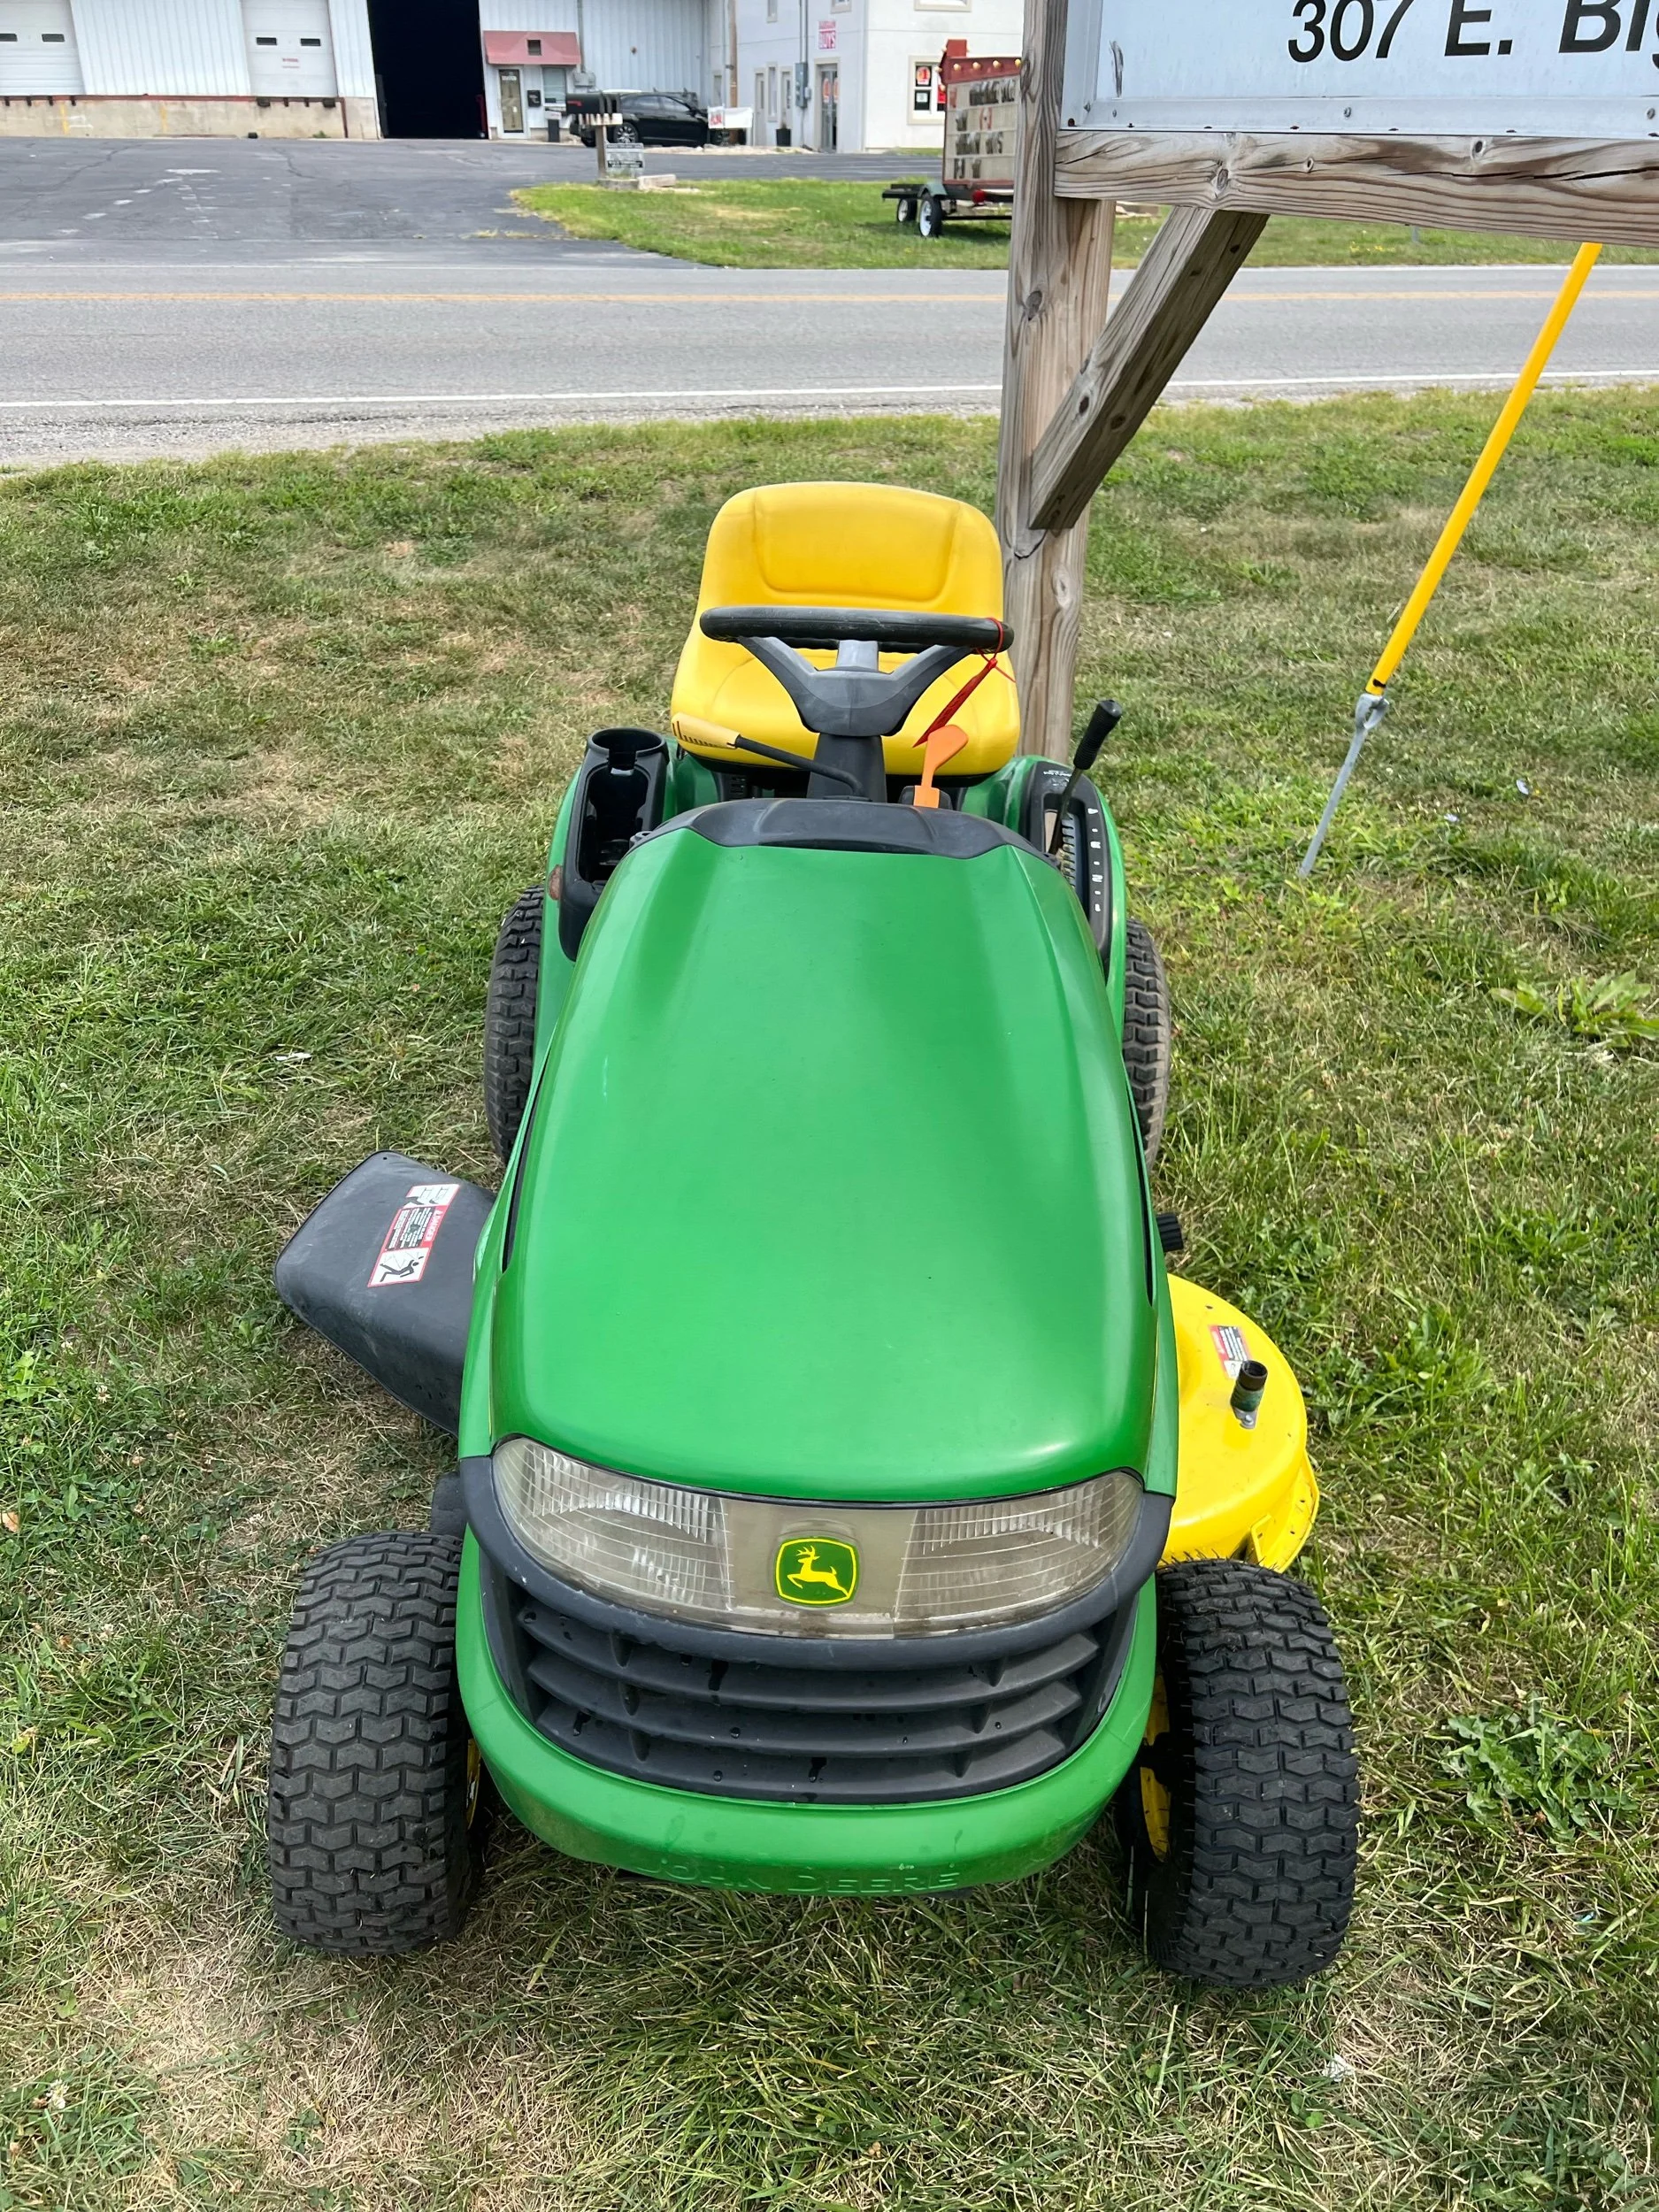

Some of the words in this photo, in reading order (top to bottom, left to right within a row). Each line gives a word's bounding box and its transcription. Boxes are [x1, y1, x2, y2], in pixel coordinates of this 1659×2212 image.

[1288, 0, 1416, 63] 307
[1558, 0, 1659, 70] Bi
[787, 1869, 961, 1893] DEERE
